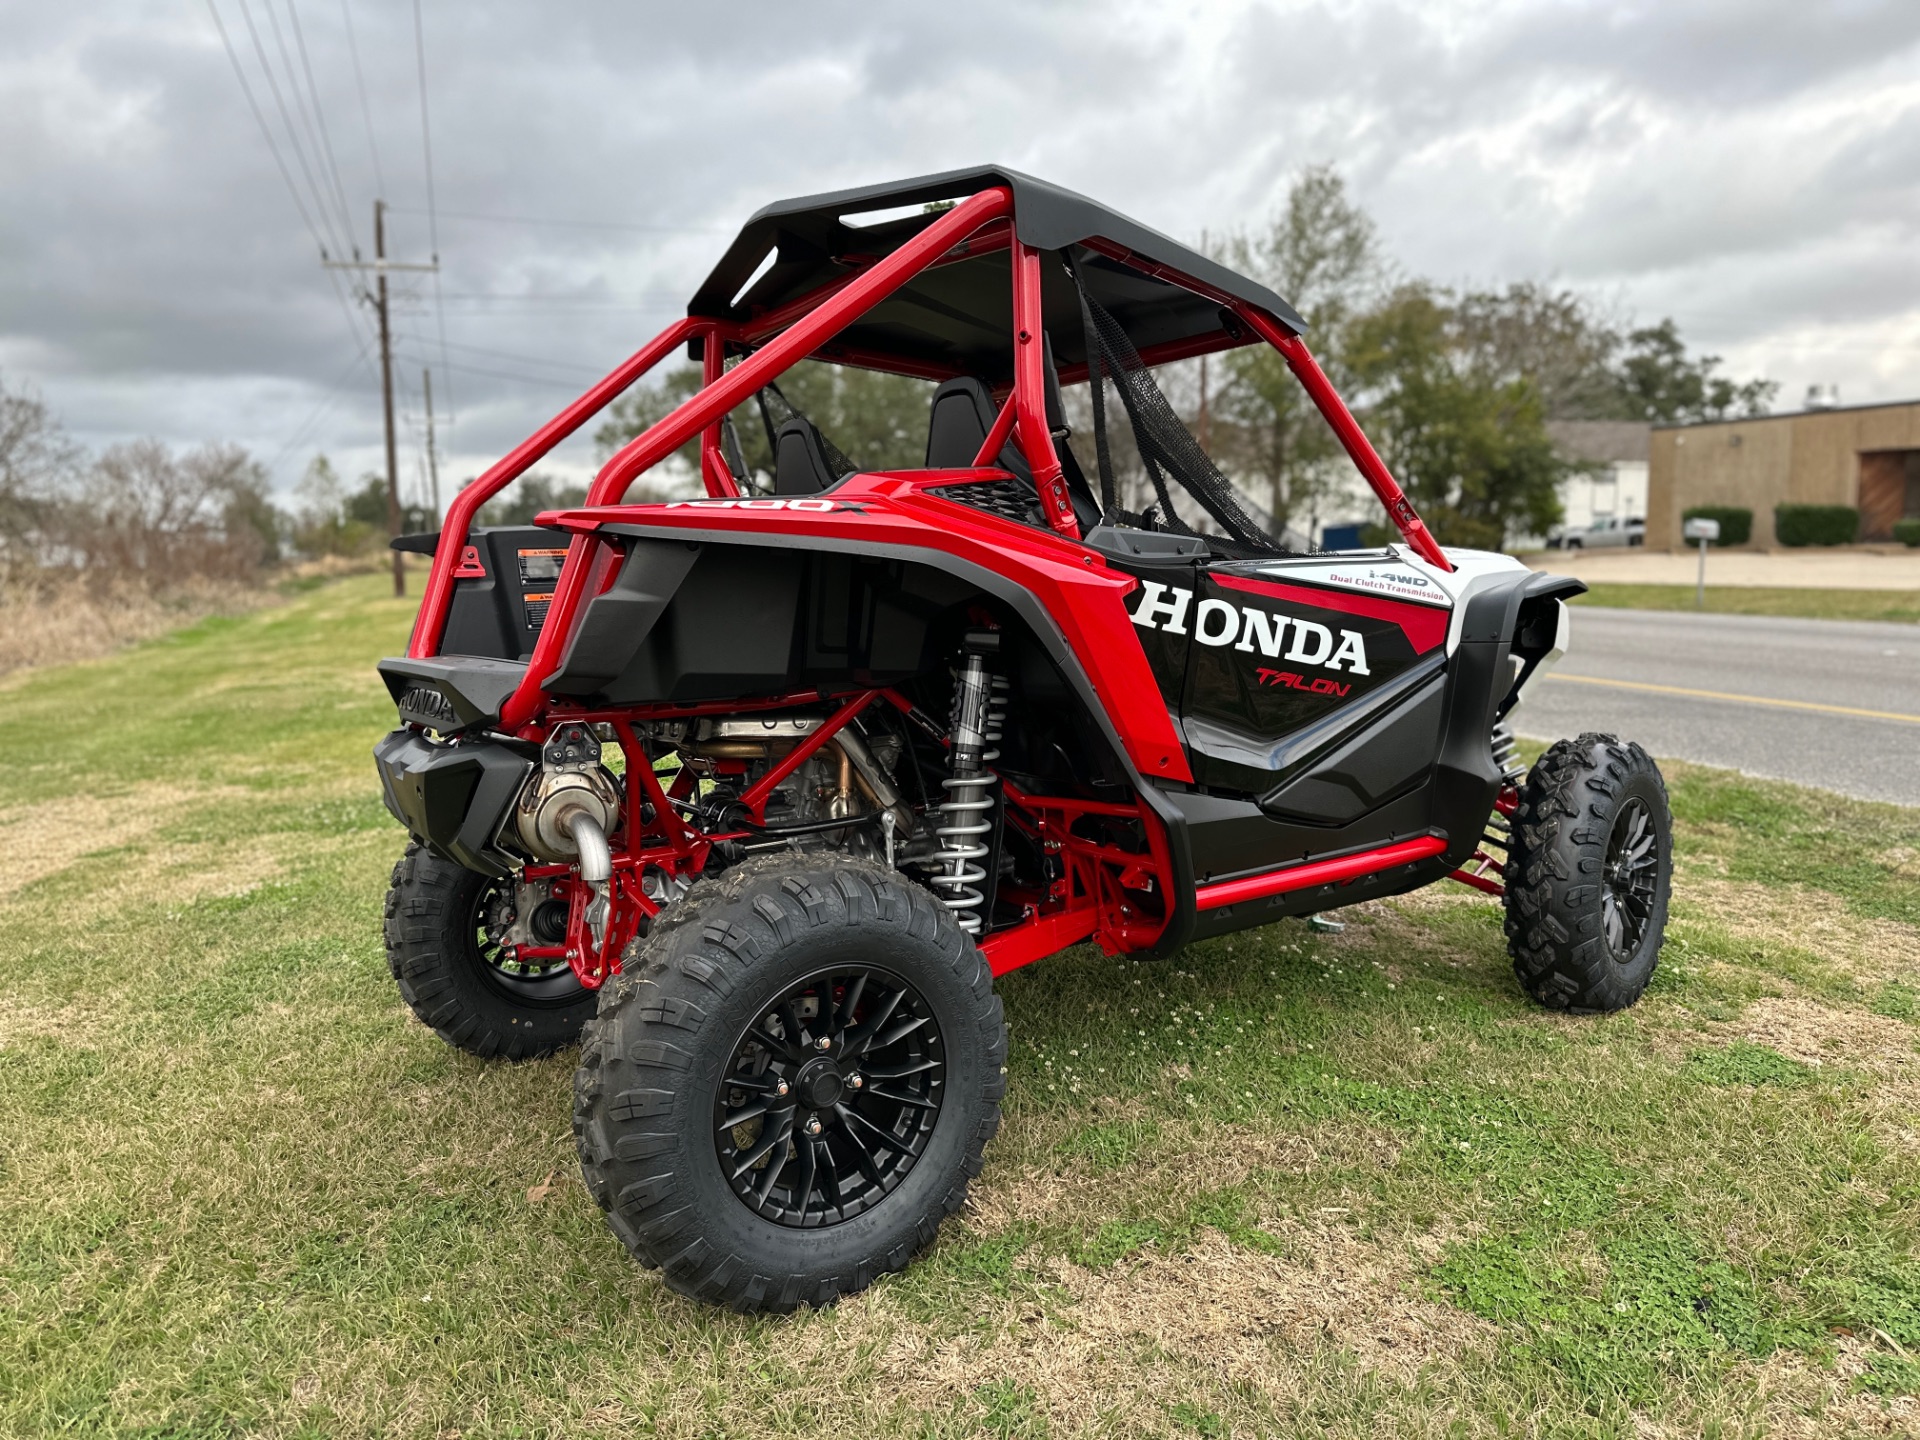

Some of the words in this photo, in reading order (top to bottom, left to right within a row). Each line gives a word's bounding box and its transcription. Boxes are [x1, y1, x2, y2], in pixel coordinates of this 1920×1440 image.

[1330, 574, 1352, 584] Dual
[1355, 578, 1385, 590] Clutch
[1386, 583, 1444, 601] Transmission
[1129, 580, 1371, 676] HONDA
[1256, 668, 1352, 697] TALON
[399, 686, 456, 723] HONDA
[690, 958, 796, 1094] KENDA
